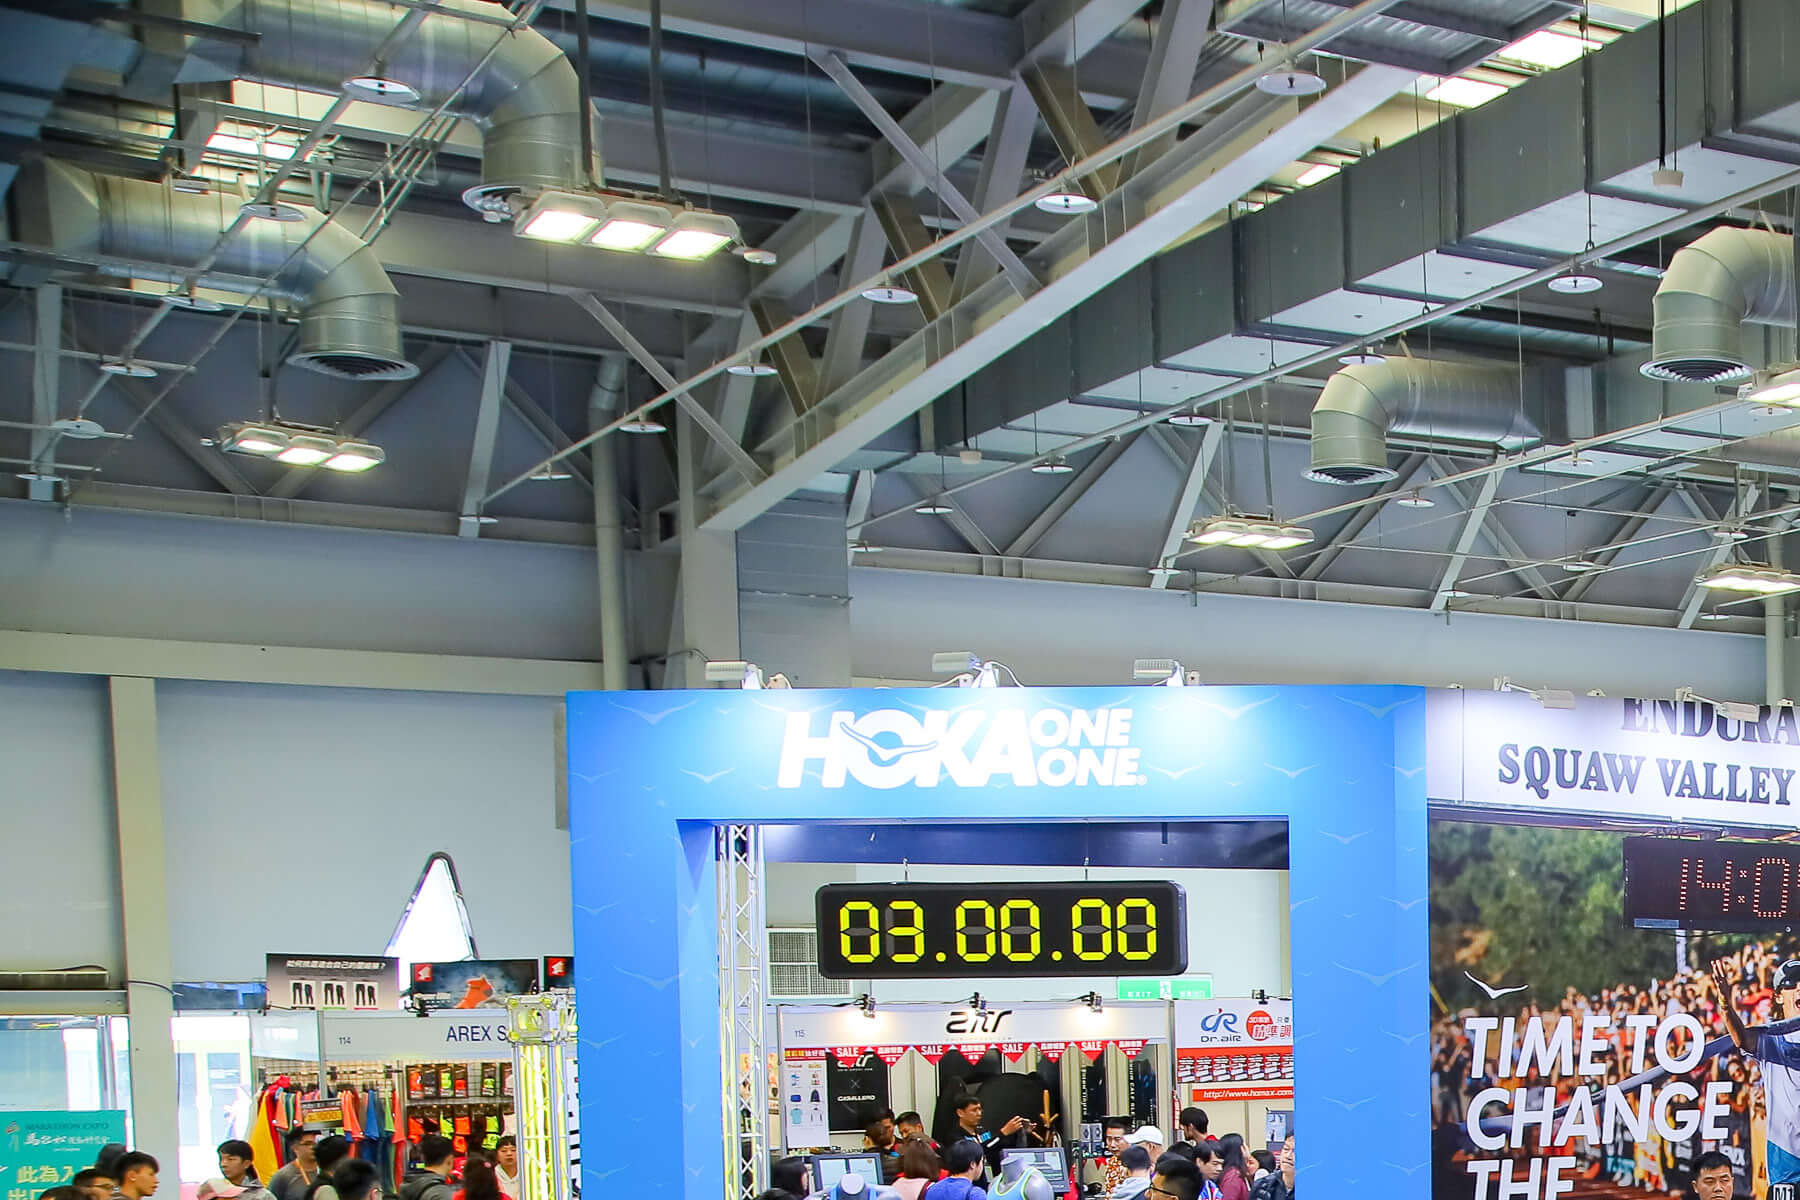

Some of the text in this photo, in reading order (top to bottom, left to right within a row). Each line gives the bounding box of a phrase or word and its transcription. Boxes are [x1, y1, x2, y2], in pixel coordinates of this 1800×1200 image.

[778, 708, 1133, 789] HOKA ONE
[1037, 748, 1139, 787] ONE
[1497, 743, 1647, 800] SQUAW
[1656, 757, 1796, 807] VALLEY
[839, 898, 1158, 964] 03.00.00
[338, 1035, 351, 1045] 114
[446, 1025, 492, 1042] AREX
[836, 1047, 859, 1058] SALE
[921, 1045, 943, 1056] SALE
[1001, 1044, 1023, 1054] SALE
[1081, 1041, 1102, 1051] SALE
[1464, 1012, 1706, 1079] TIME TO
[1466, 1080, 1734, 1151] CHANGE
[16, 1165, 96, 1184] 此為入
